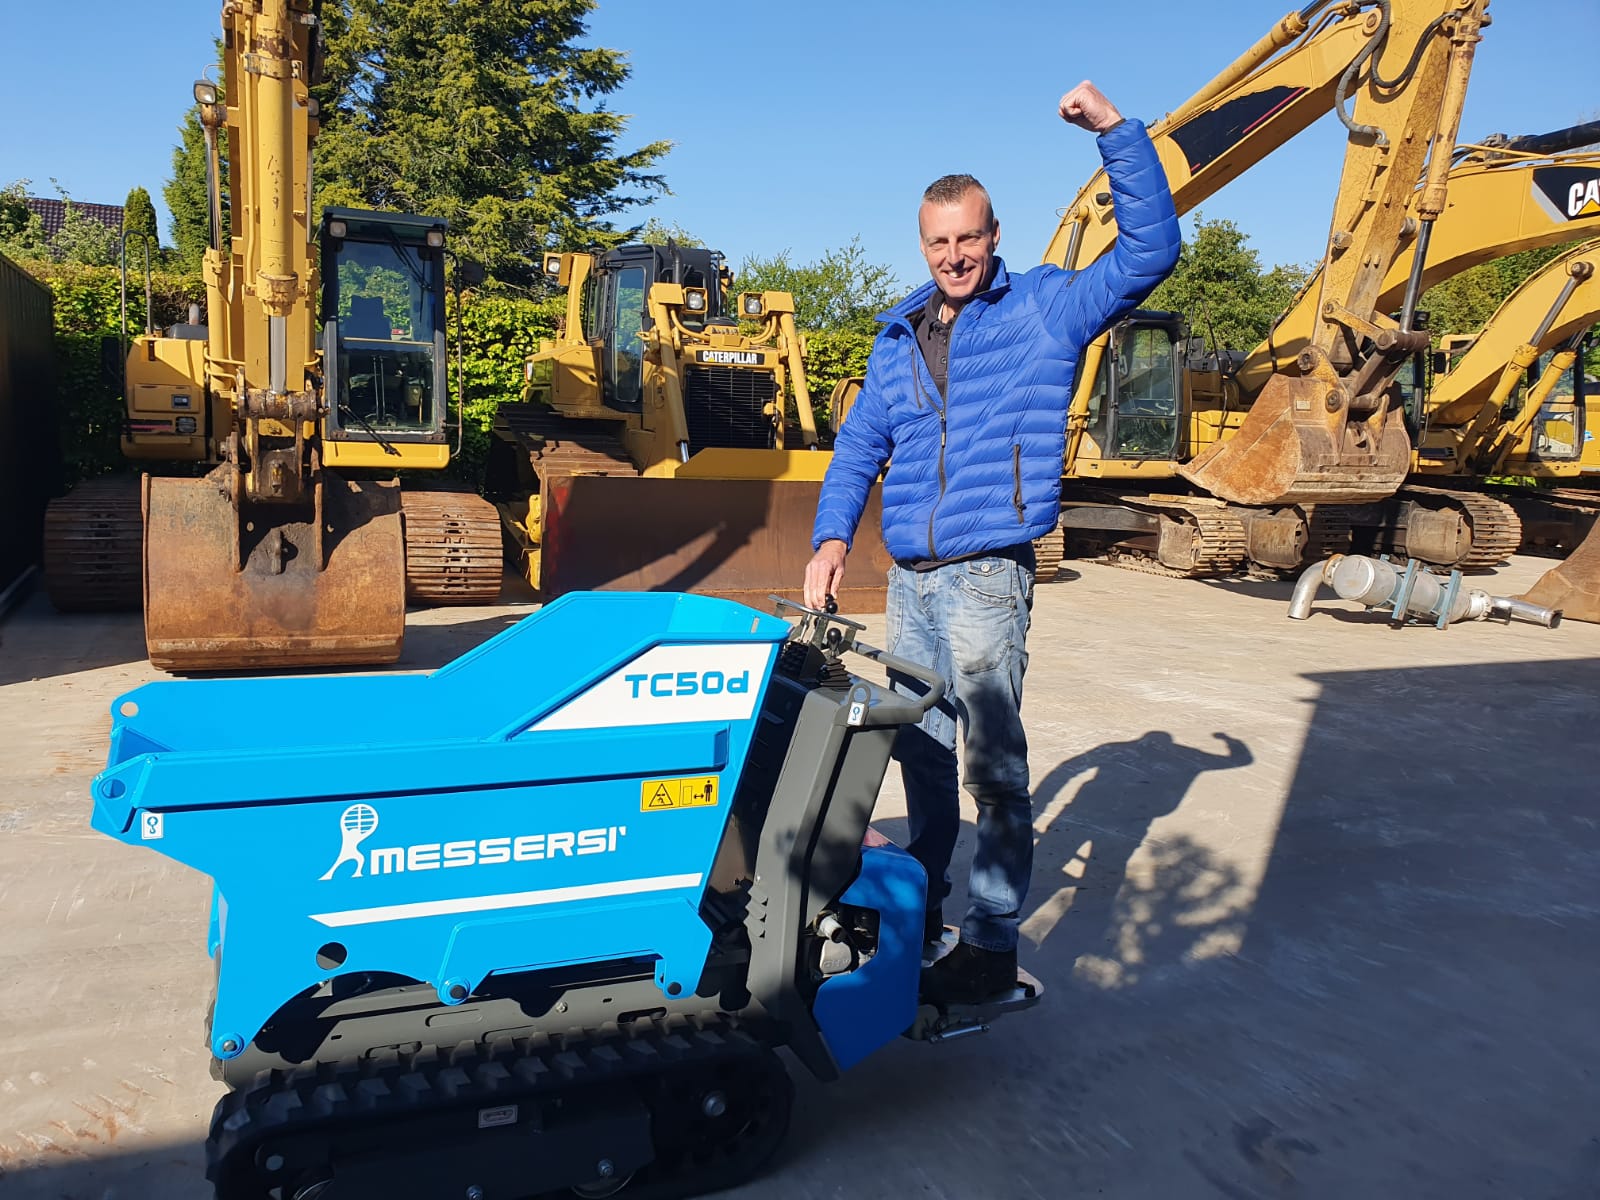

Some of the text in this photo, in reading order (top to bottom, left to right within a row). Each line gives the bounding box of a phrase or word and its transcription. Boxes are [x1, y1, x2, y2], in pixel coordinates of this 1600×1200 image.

[1568, 178, 1600, 216] CA
[703, 350, 758, 364] CATERPILLAR
[625, 670, 749, 698] TC50d
